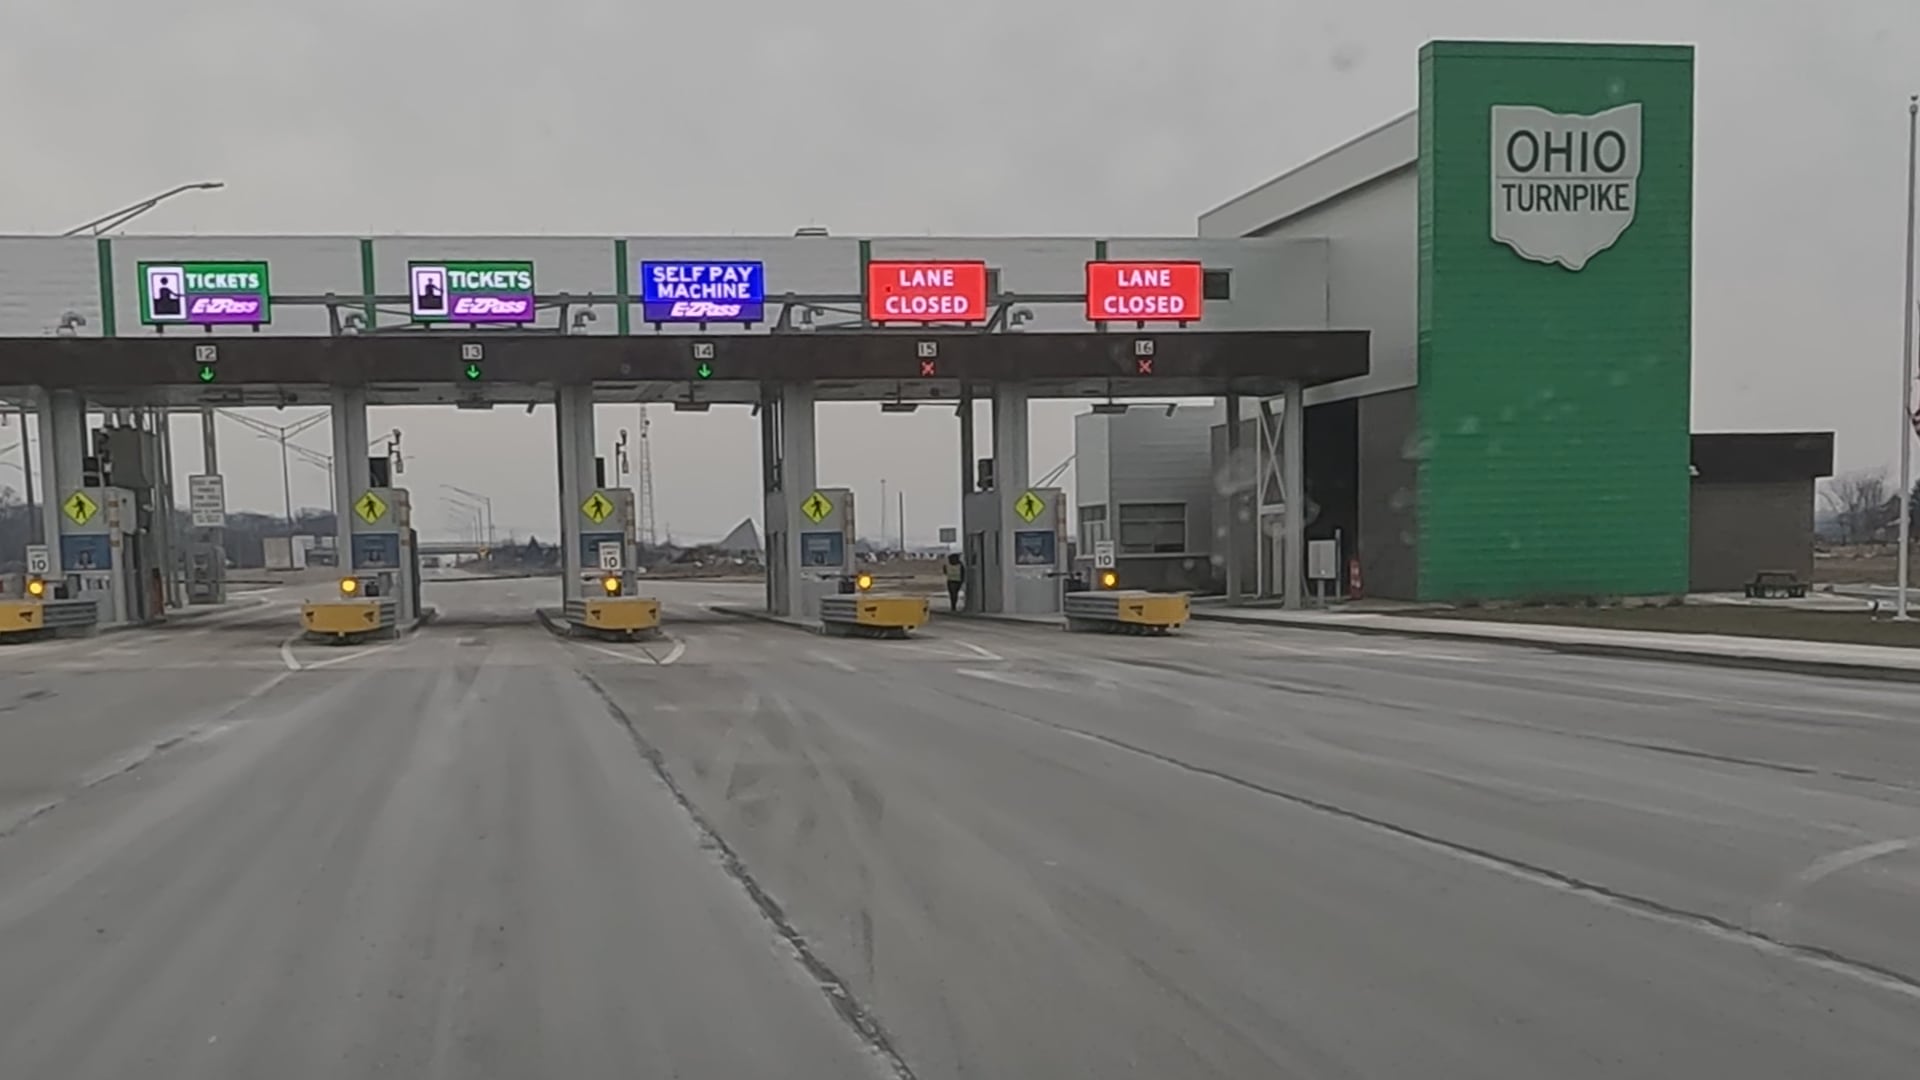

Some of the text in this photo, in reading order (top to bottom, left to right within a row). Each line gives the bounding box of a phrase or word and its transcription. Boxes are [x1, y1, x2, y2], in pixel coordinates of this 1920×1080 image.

[1507, 130, 1626, 173] OHIO
[1502, 184, 1630, 212] TURNPIKE
[186, 273, 259, 289] TICKETS
[448, 270, 531, 289] TICKETS
[653, 266, 753, 282] SELF PAY
[899, 269, 954, 287] LANE
[1118, 269, 1171, 287] LANE
[657, 283, 751, 299] MACHINE
[885, 296, 969, 314] CLOSED
[1103, 296, 1185, 313] CLOSED
[198, 347, 215, 360] 12
[464, 346, 481, 358] 13
[696, 345, 712, 357] 14
[919, 343, 936, 355] 15
[1137, 342, 1153, 354] 16
[31, 559, 46, 571] 10
[604, 557, 618, 568] 10
[1098, 555, 1112, 566] 10
